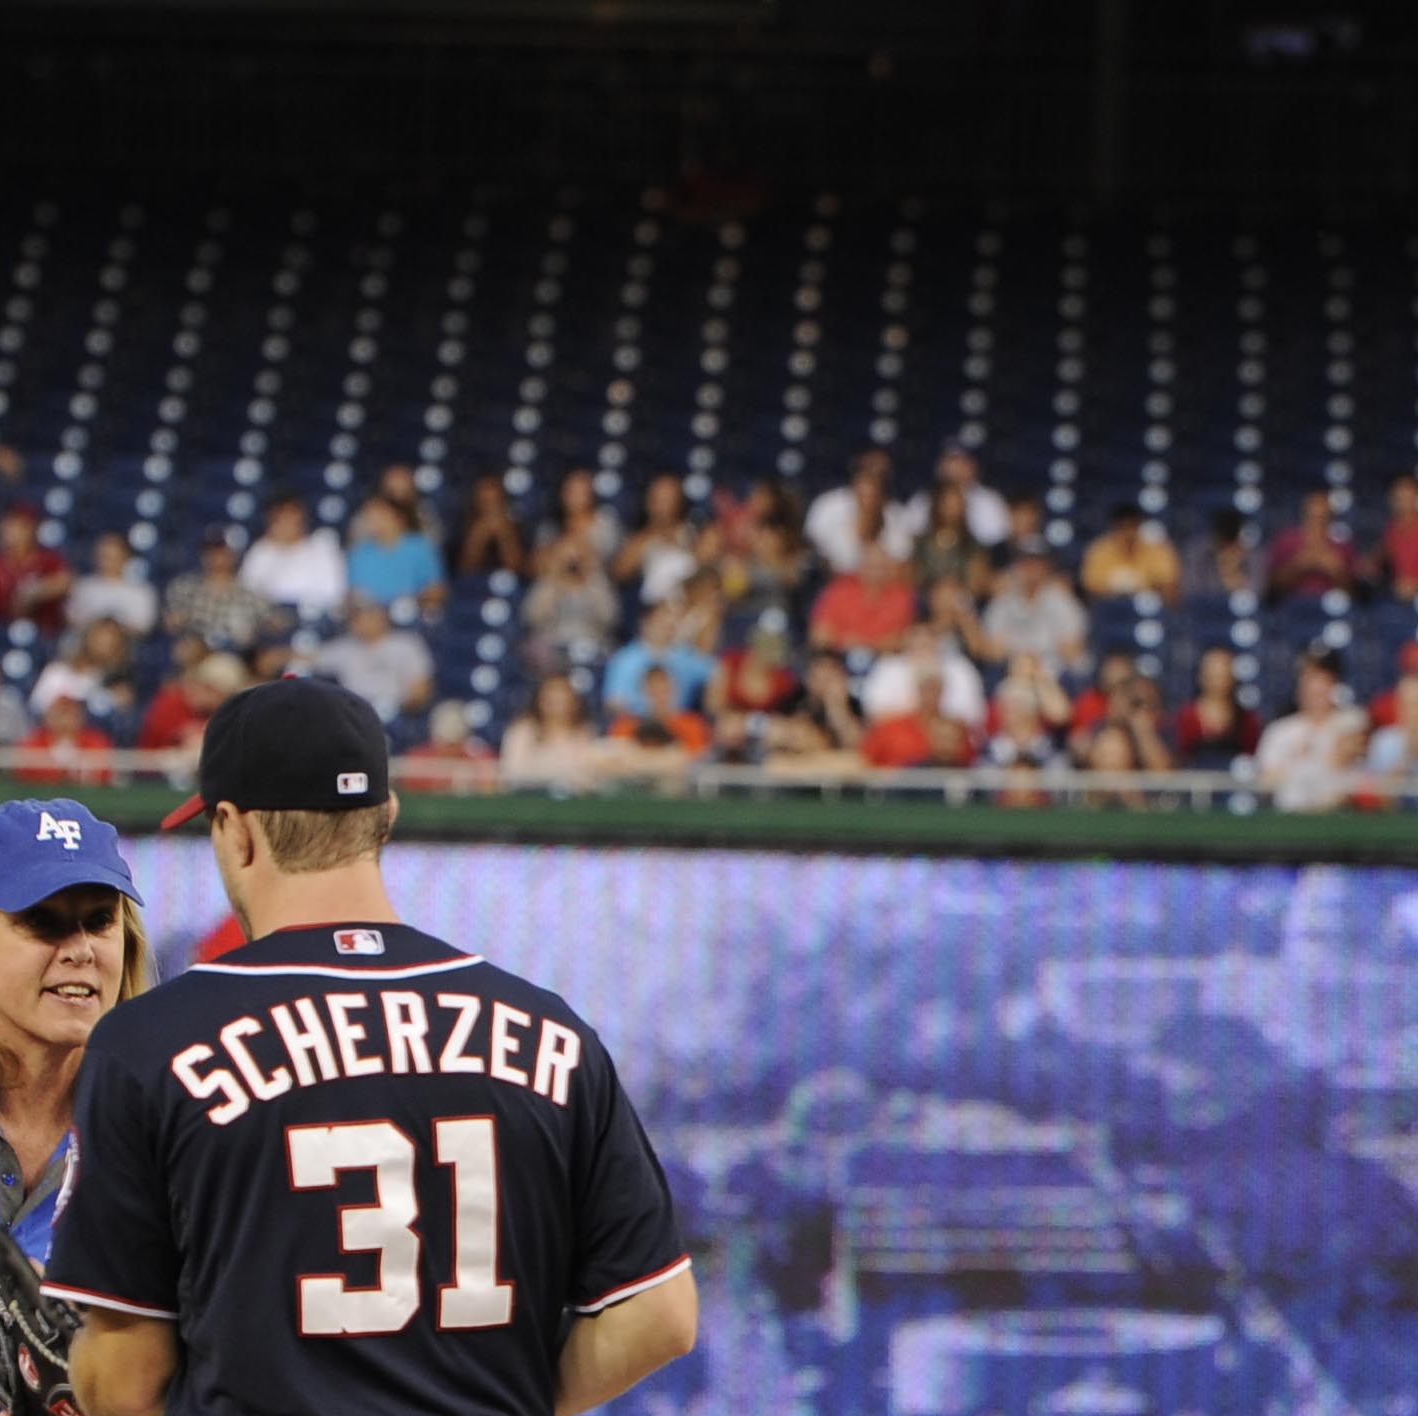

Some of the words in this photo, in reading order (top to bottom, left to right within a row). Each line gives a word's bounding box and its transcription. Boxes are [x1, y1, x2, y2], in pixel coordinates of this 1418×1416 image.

[36, 811, 82, 850] AF
[171, 990, 581, 1126] SCHERZER
[285, 1115, 516, 1339] 31
